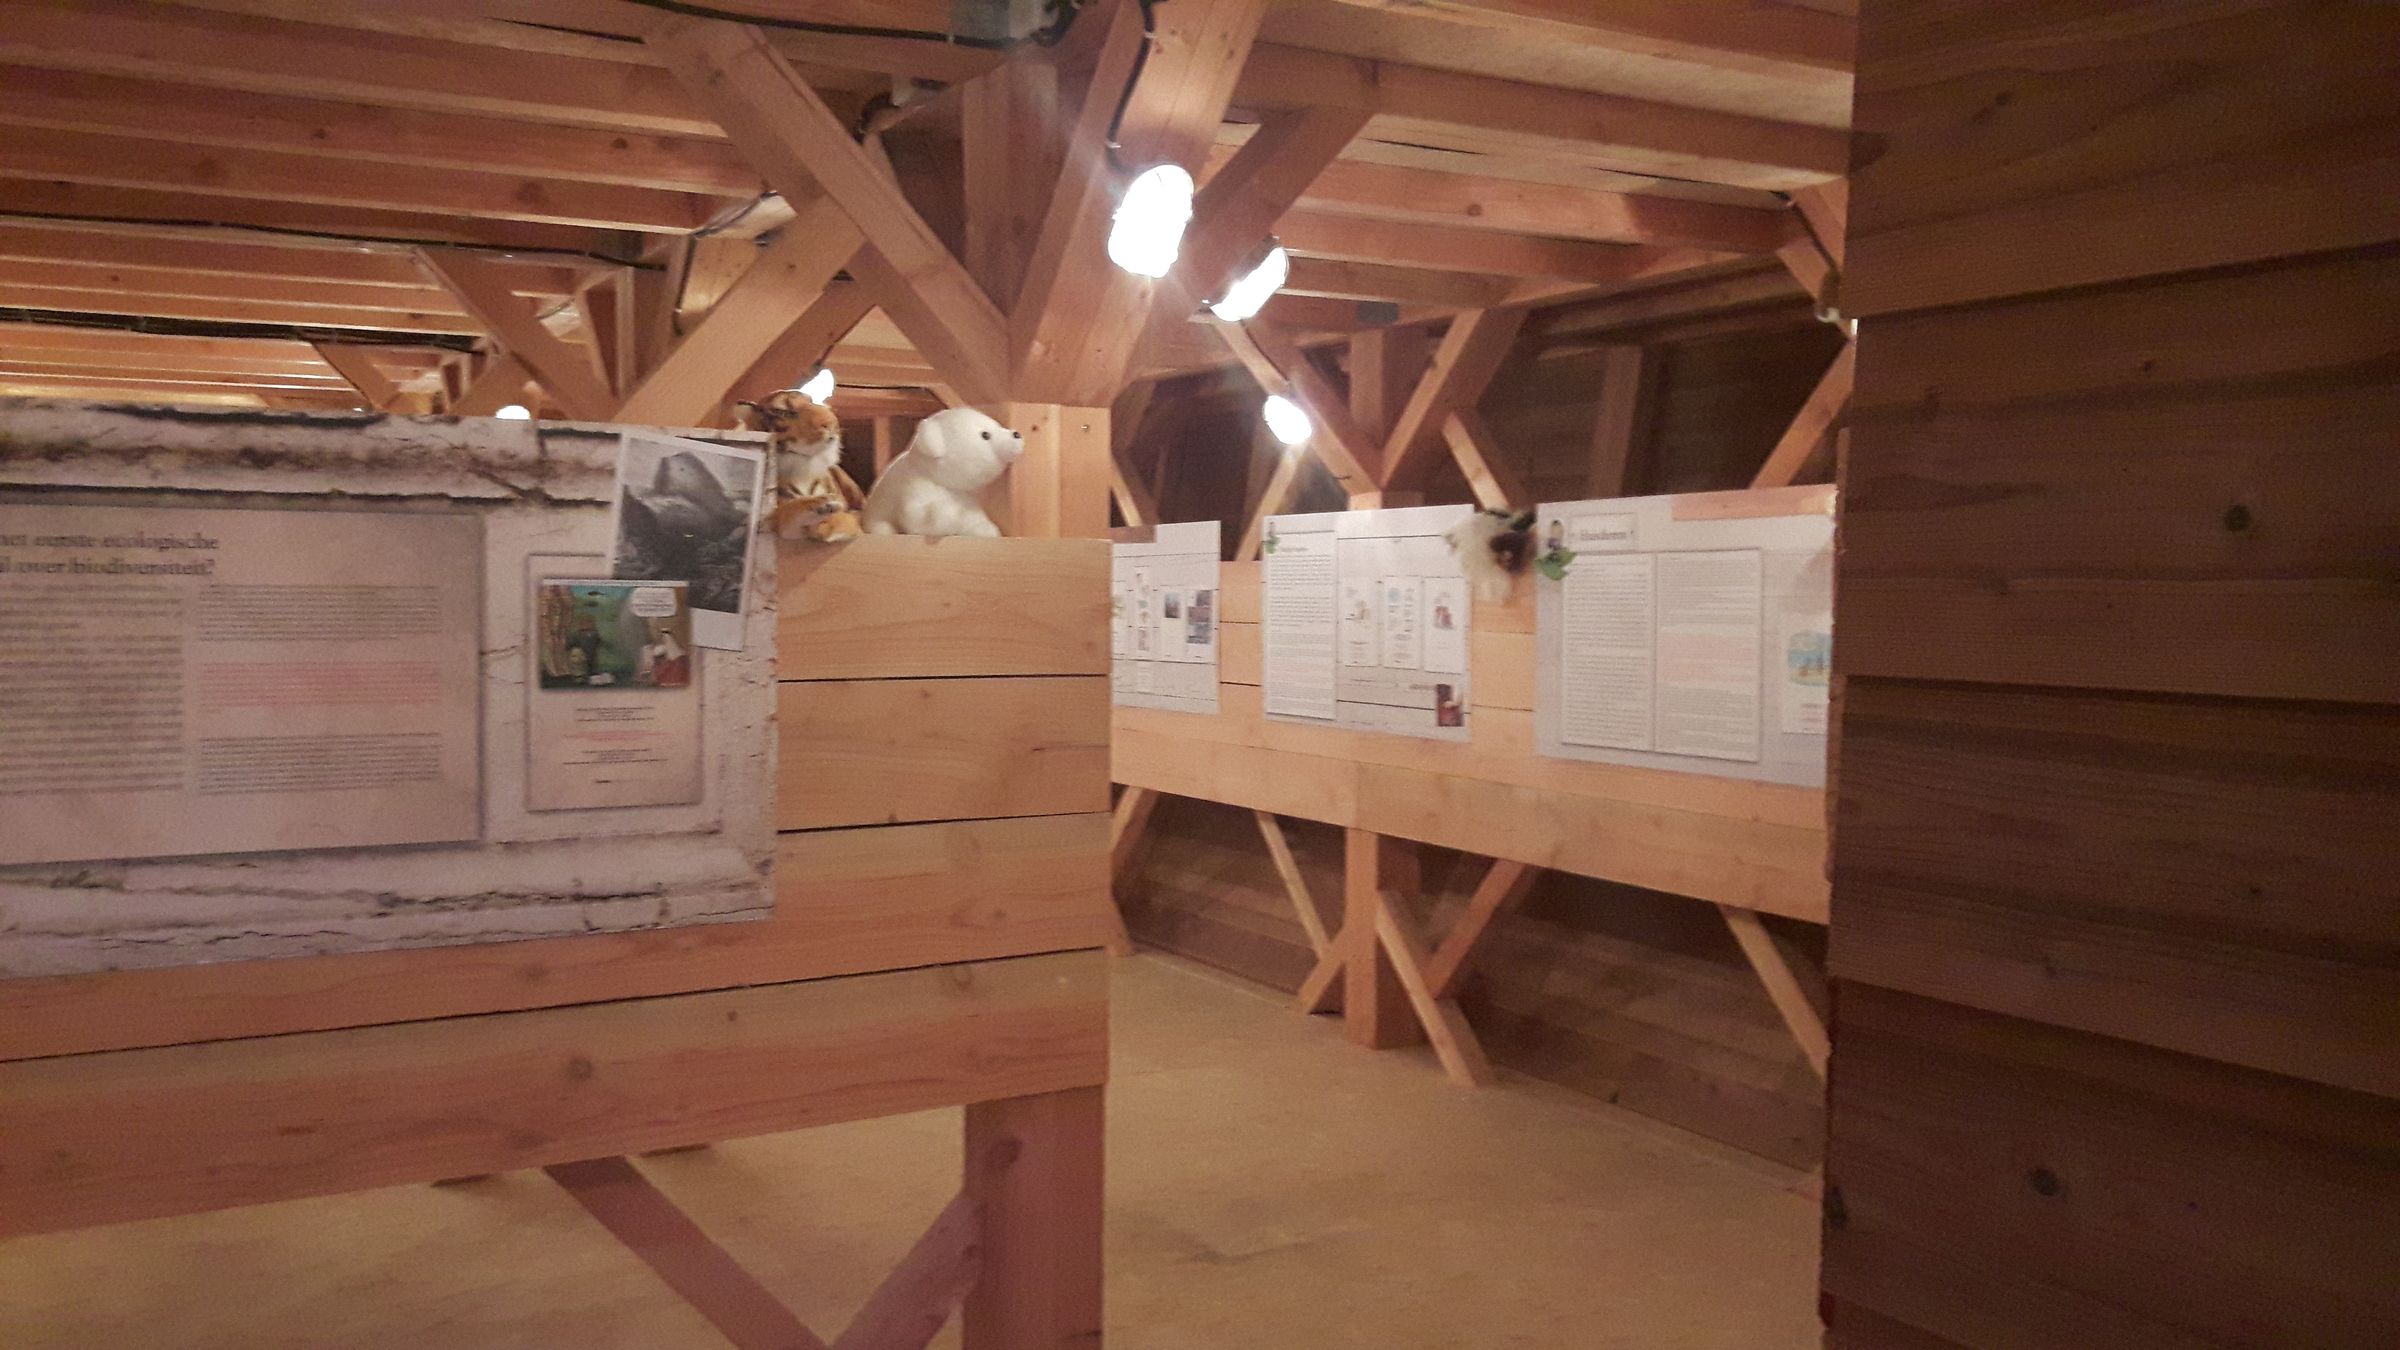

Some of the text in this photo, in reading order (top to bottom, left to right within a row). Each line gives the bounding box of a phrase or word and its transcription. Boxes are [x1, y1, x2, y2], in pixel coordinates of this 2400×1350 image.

[35, 535, 97, 548] eerste
[103, 530, 219, 552] ecologische
[17, 562, 66, 575] over
